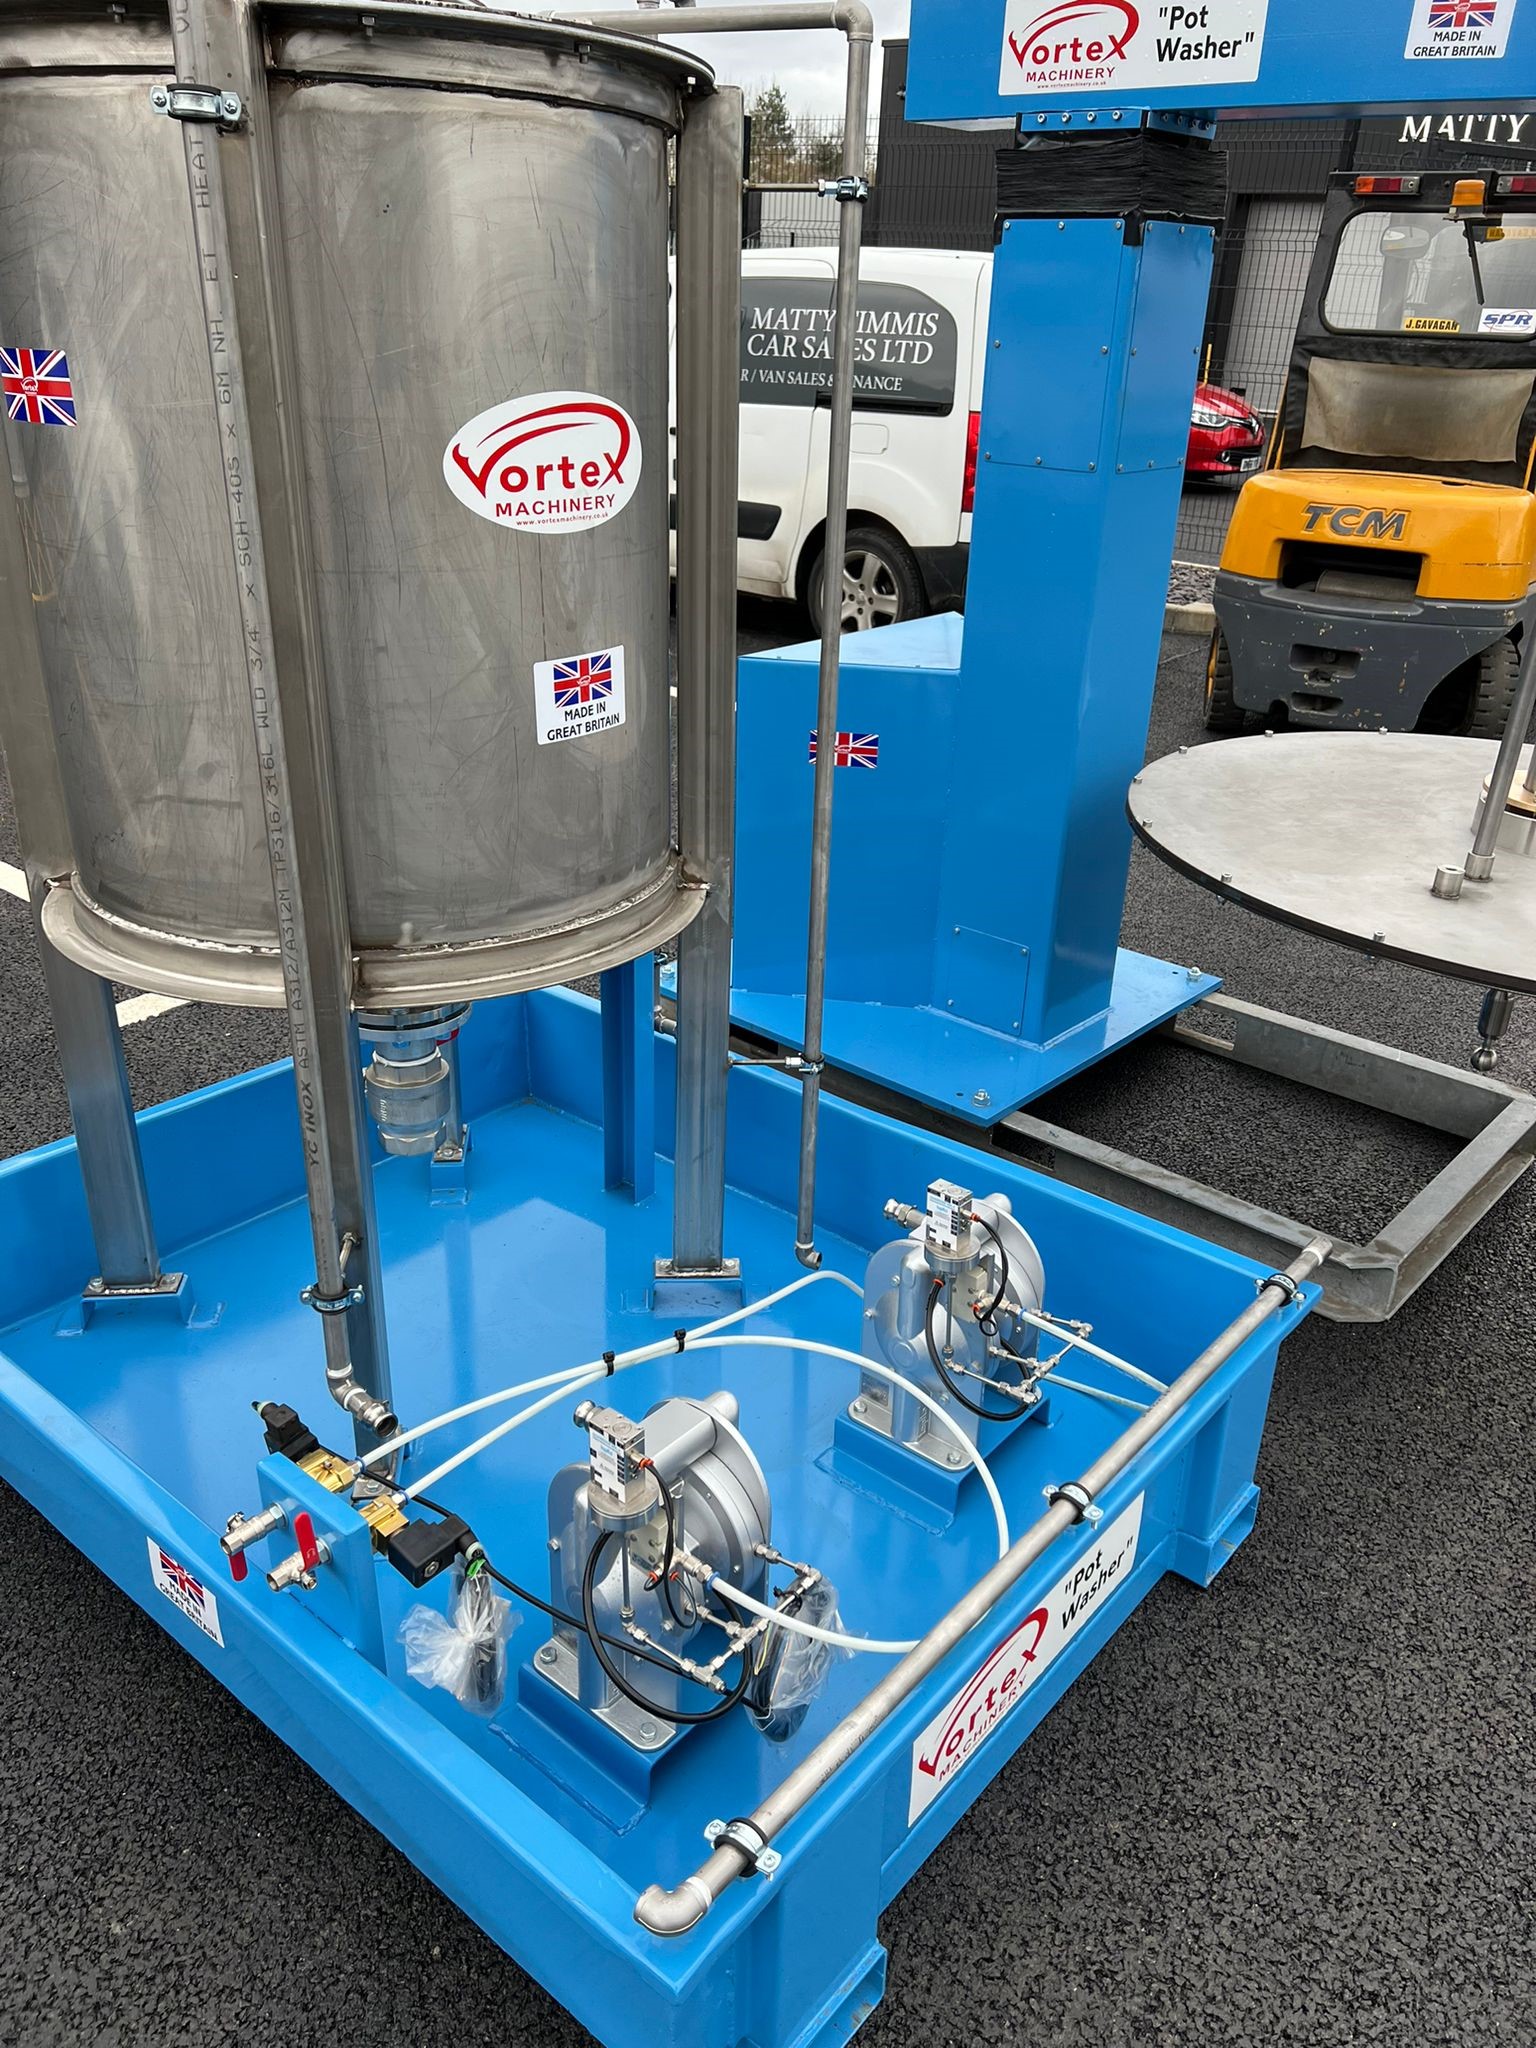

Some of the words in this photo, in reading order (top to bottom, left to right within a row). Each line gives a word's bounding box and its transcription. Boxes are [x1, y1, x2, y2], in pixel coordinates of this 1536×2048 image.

[1158, 4, 1209, 30] "Pot
[1156, 31, 1255, 62] Washer"
[1413, 46, 1450, 57] GREAT
[1451, 45, 1497, 57] BRITAIN
[1433, 31, 1467, 42] MADE
[1468, 30, 1482, 41] IN
[1025, 67, 1116, 83] MACHINERY
[1398, 114, 1531, 143] MATTY
[189, 134, 211, 209] HEAT
[202, 247, 219, 283] ET
[750, 307, 837, 332] MATTY
[1482, 313, 1534, 326] SPR
[747, 333, 798, 358] CAR
[801, 335, 877, 362] SAES
[880, 339, 934, 365] LTD
[216, 371, 232, 405] 6M
[758, 369, 786, 384] VAN
[786, 371, 827, 387] SALES
[852, 374, 904, 391] NANCE
[228, 455, 252, 567] SCH-40S
[495, 493, 616, 518] MACHINERY
[516, 511, 609, 526] www.vortexmachinery.co.uk
[1303, 502, 1408, 541] TCM
[254, 686, 270, 729] WLD
[564, 704, 594, 722] MADE
[596, 701, 606, 714] IN
[547, 723, 582, 741] GREAT
[585, 712, 620, 733] BRITAIN
[279, 887, 301, 1012] A312/A312M
[293, 1023, 310, 1070] ASTM
[302, 1079, 317, 1134] INOX
[938, 1676, 1028, 1782] MACHINERY
